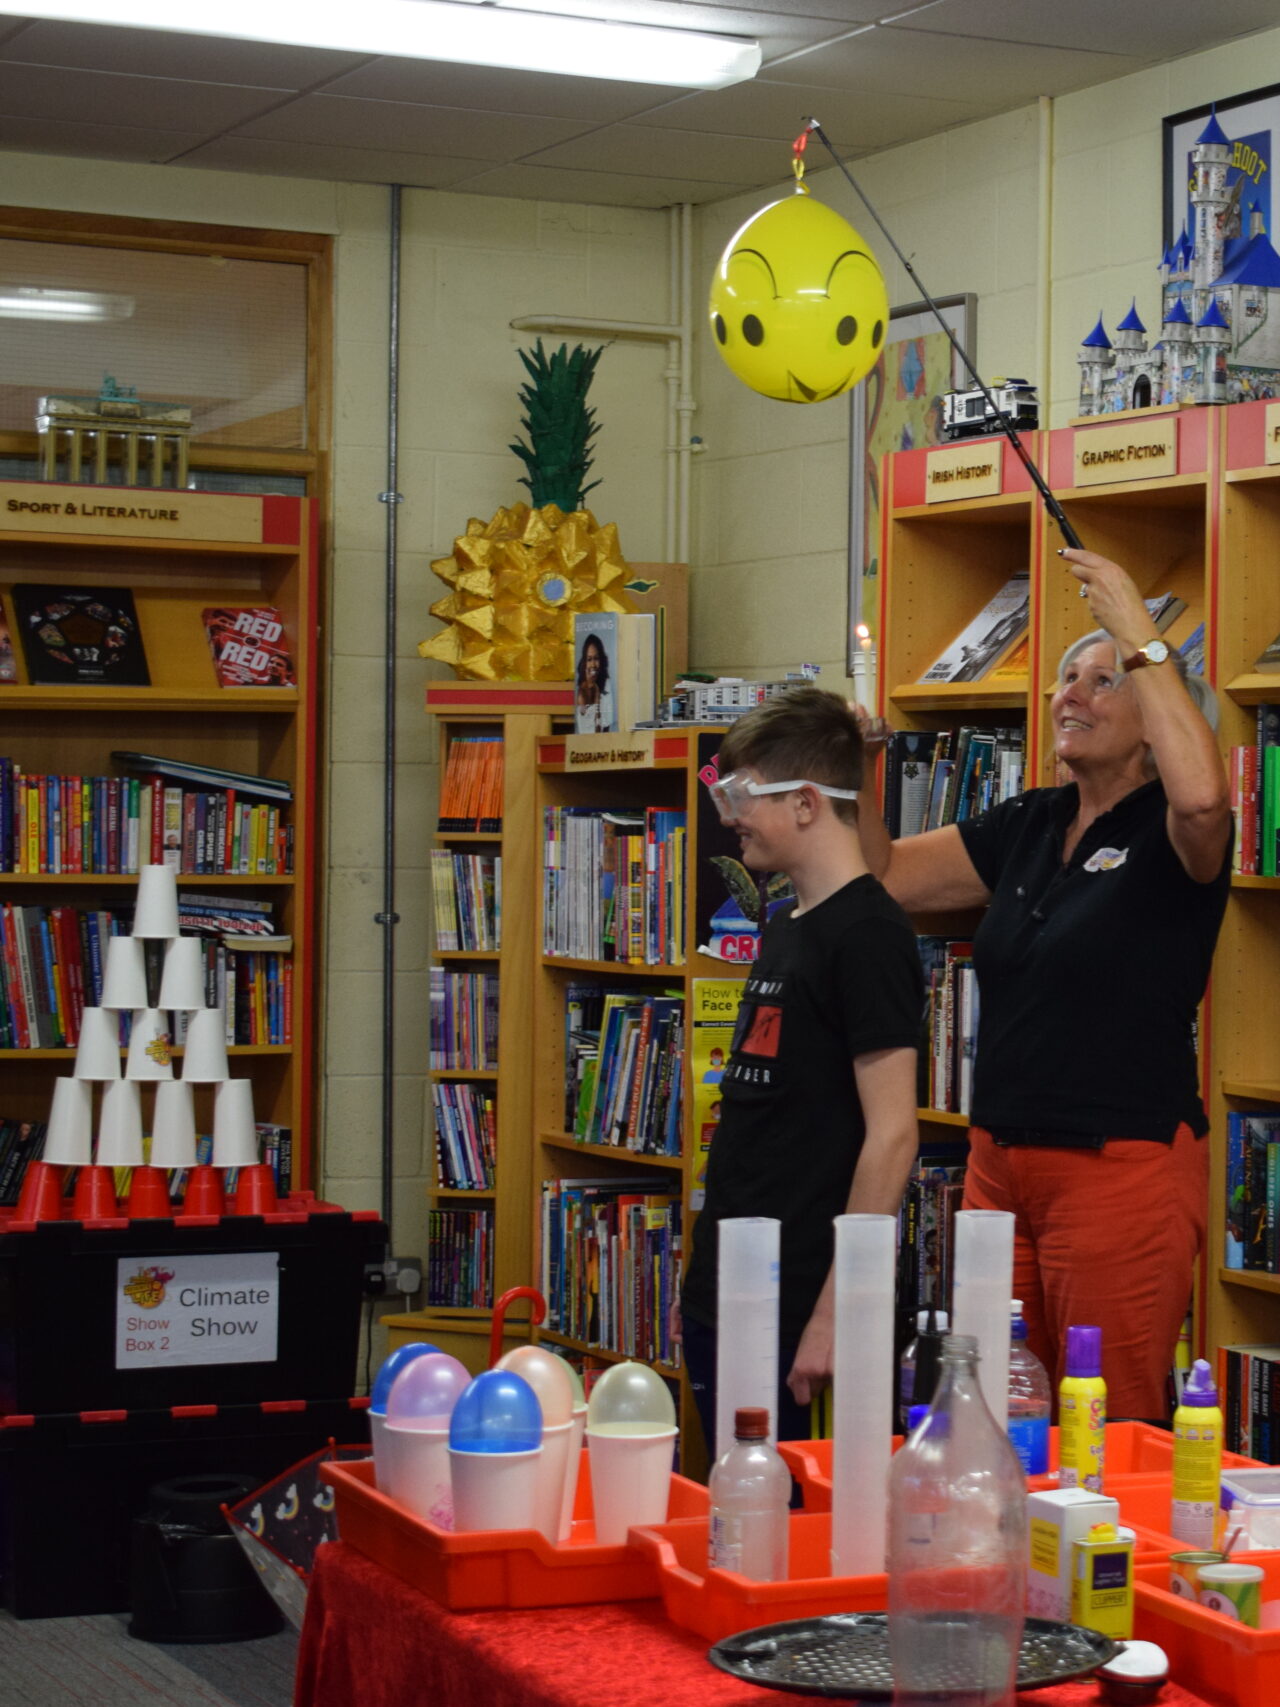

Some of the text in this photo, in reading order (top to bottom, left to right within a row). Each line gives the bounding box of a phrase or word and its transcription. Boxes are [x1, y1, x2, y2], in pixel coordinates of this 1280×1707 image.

[1231, 141, 1268, 185] HOOT
[1082, 445, 1166, 466] GRAPHIC FICTION
[932, 463, 993, 485] IRISH HISTORY
[7, 499, 180, 521] SPORT & LITERATURE
[233, 612, 284, 643] RED
[220, 641, 271, 672] RED
[196, 830, 205, 864] CHELSEA
[206, 832, 215, 862] SPURS
[217, 828, 226, 865] NEWCASTLE
[702, 988, 731, 999] How
[702, 999, 733, 1011] Face
[1267, 1200, 1275, 1229] ONES
[178, 1287, 271, 1308] Climate
[126, 1317, 170, 1332] Show
[190, 1318, 259, 1337] Show
[125, 1336, 170, 1352] Box 2
